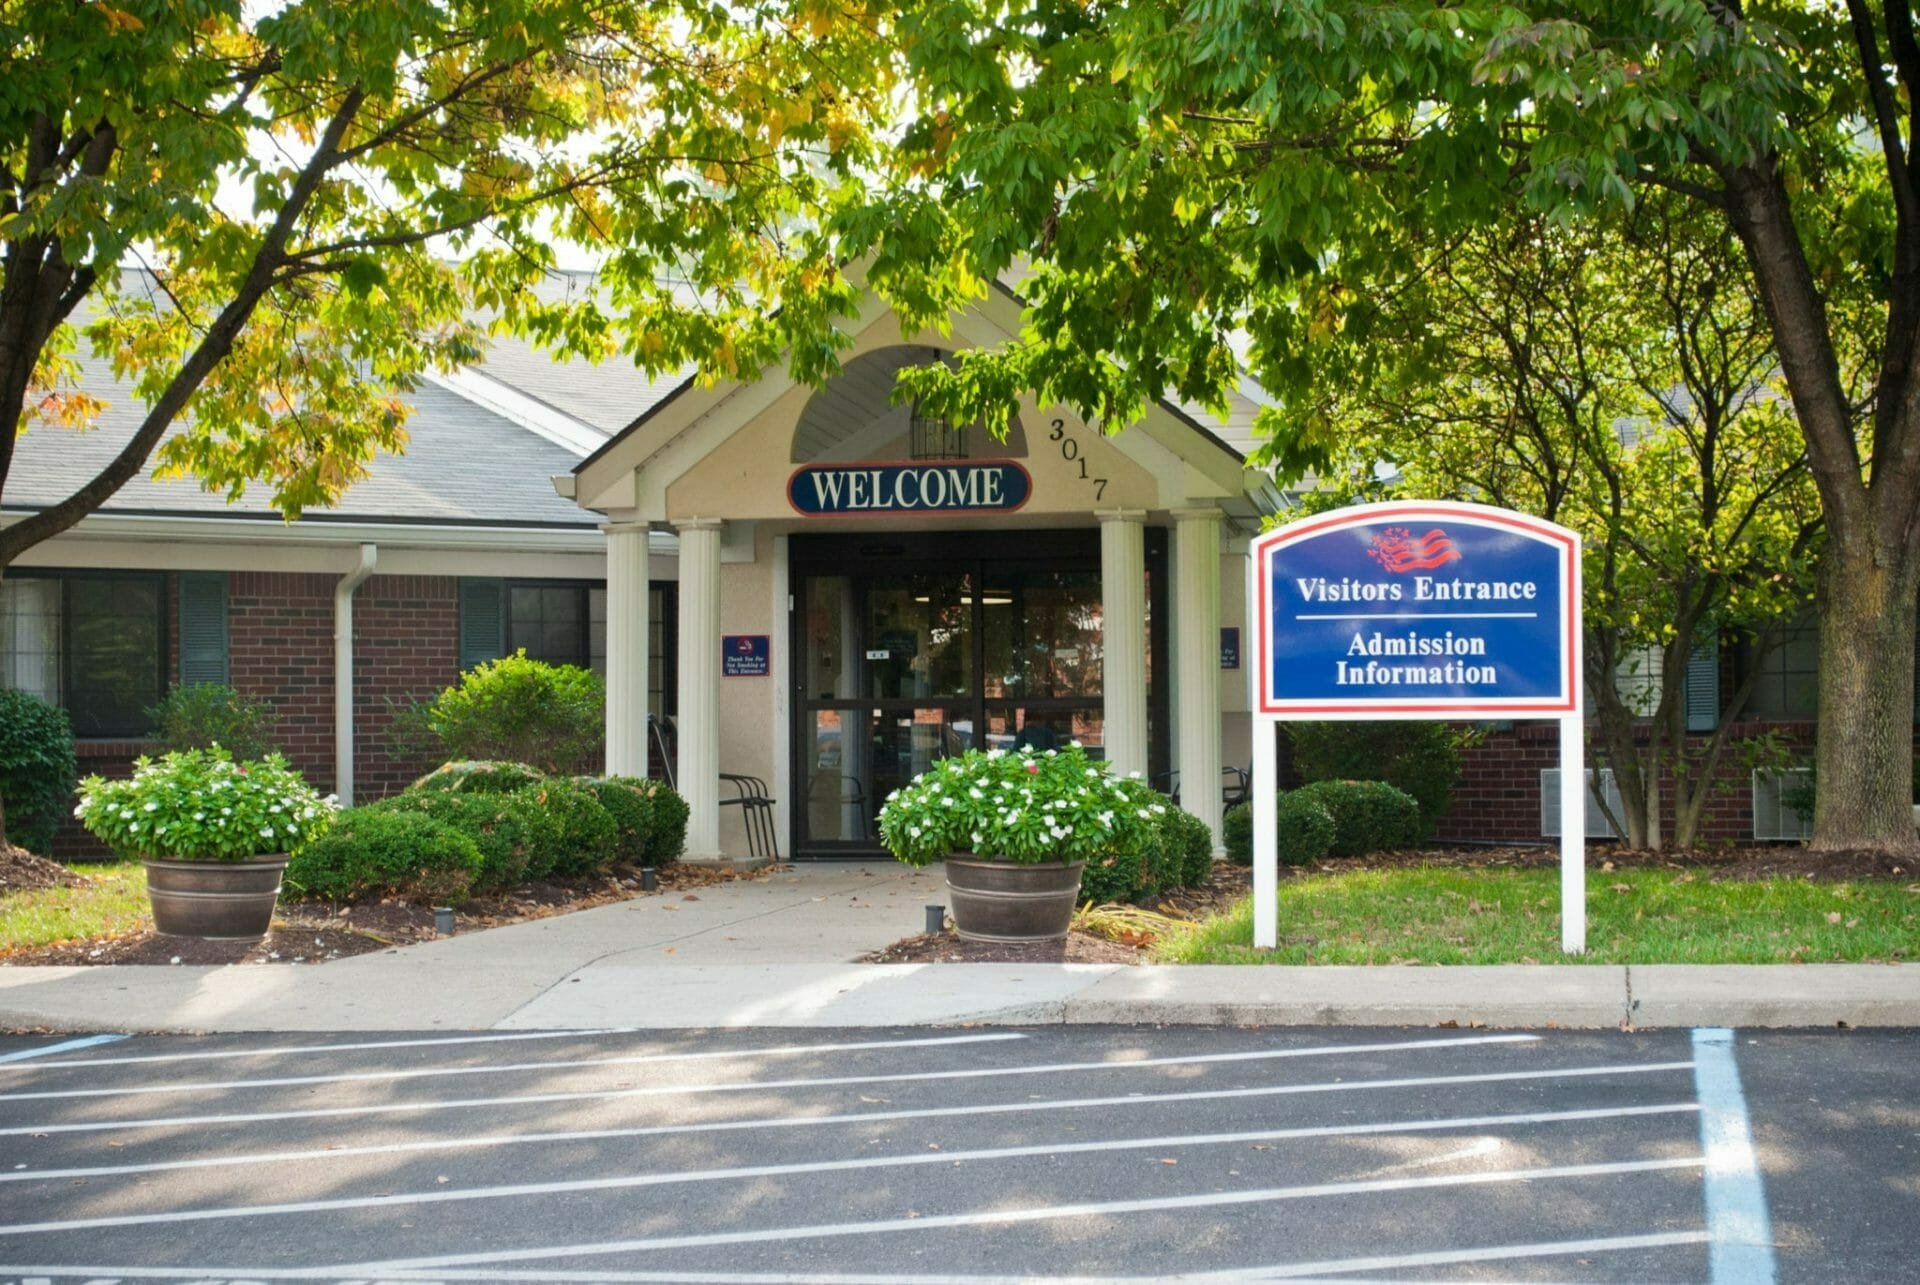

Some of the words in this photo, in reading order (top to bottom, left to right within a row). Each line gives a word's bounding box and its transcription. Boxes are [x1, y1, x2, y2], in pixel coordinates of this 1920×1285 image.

[1050, 419, 1107, 501] 3017
[811, 468, 1004, 510] WELCOME
[1297, 577, 1402, 602] Visitors
[1414, 576, 1536, 600] Entrance
[1347, 632, 1486, 656] Admission
[1336, 660, 1497, 685] Information
